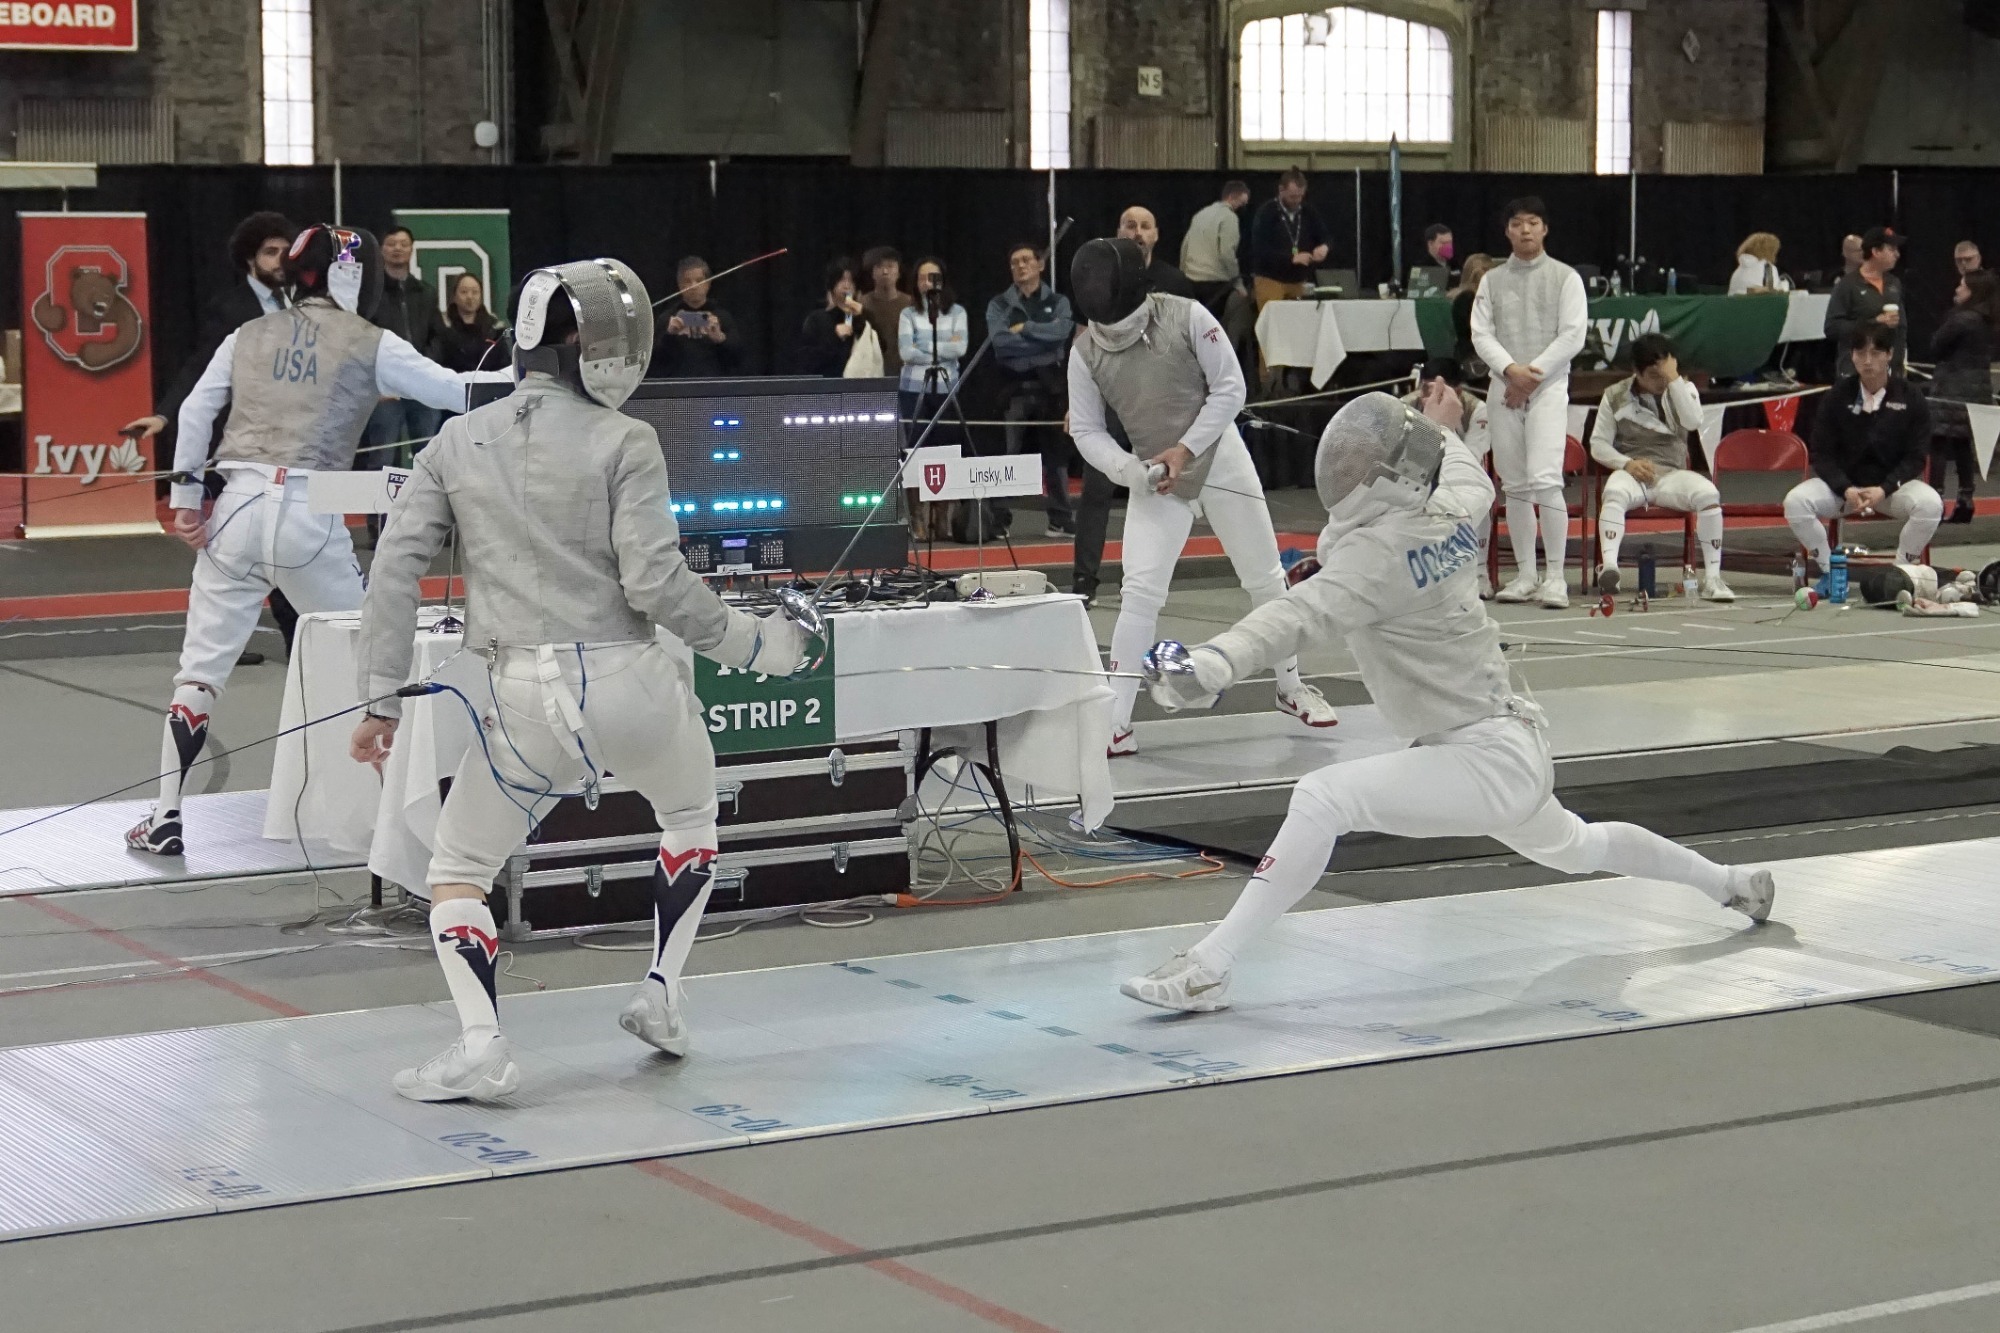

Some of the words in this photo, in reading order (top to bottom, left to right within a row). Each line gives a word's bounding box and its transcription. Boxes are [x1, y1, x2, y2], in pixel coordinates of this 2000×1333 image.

[292, 316, 321, 348] YU
[273, 348, 318, 384] USA
[34, 435, 106, 485] Ivy
[969, 466, 1002, 486] Linsky,
[1004, 465, 1017, 482] M.
[390, 474, 406, 483] PEN
[929, 467, 941, 486] H
[708, 699, 798, 733] STRIP
[804, 697, 821, 724] 2
[692, 1103, 793, 1132] 10-19
[439, 1131, 540, 1164] 10-20
